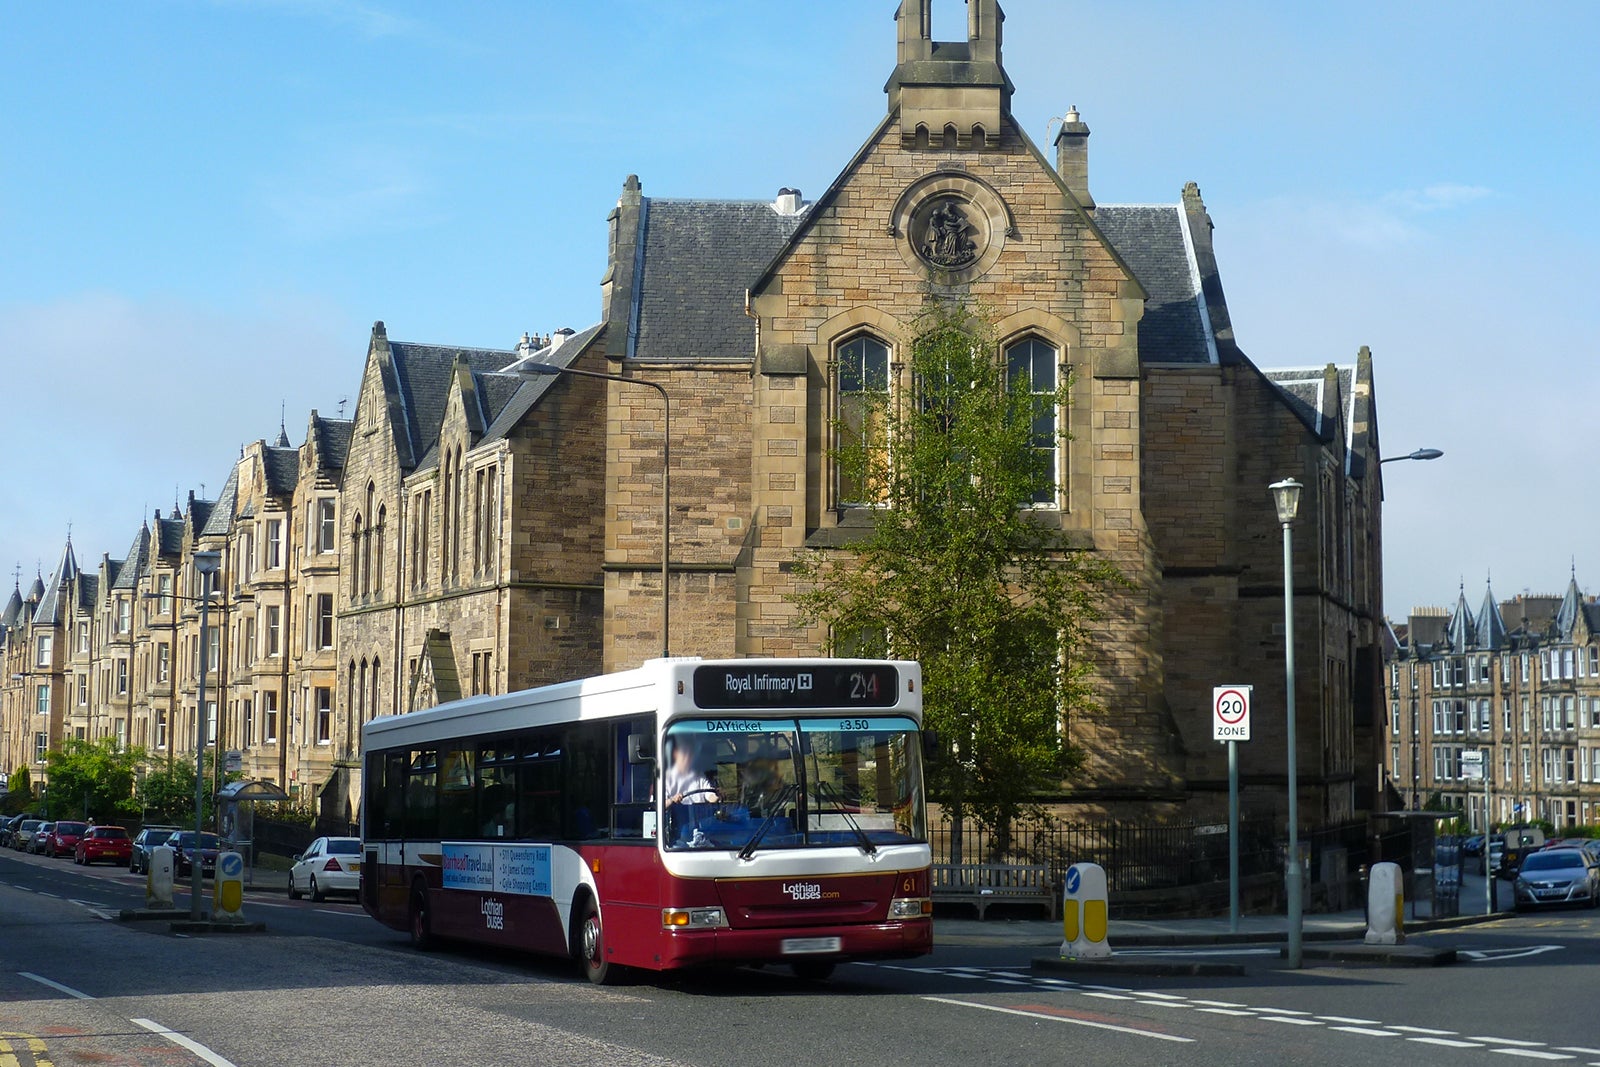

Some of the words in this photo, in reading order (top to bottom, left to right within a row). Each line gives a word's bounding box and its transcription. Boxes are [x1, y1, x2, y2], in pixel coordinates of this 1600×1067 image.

[725, 673, 752, 694] Royal
[754, 673, 796, 693] Infirmary
[1221, 700, 1242, 714] 20
[706, 720, 763, 732] DAYticket
[839, 719, 869, 731] £3.50
[1217, 726, 1246, 736] ZONE
[783, 882, 820, 893] Lothian
[903, 878, 915, 892] 61
[481, 896, 503, 916] Lothian
[487, 915, 503, 930] buses
